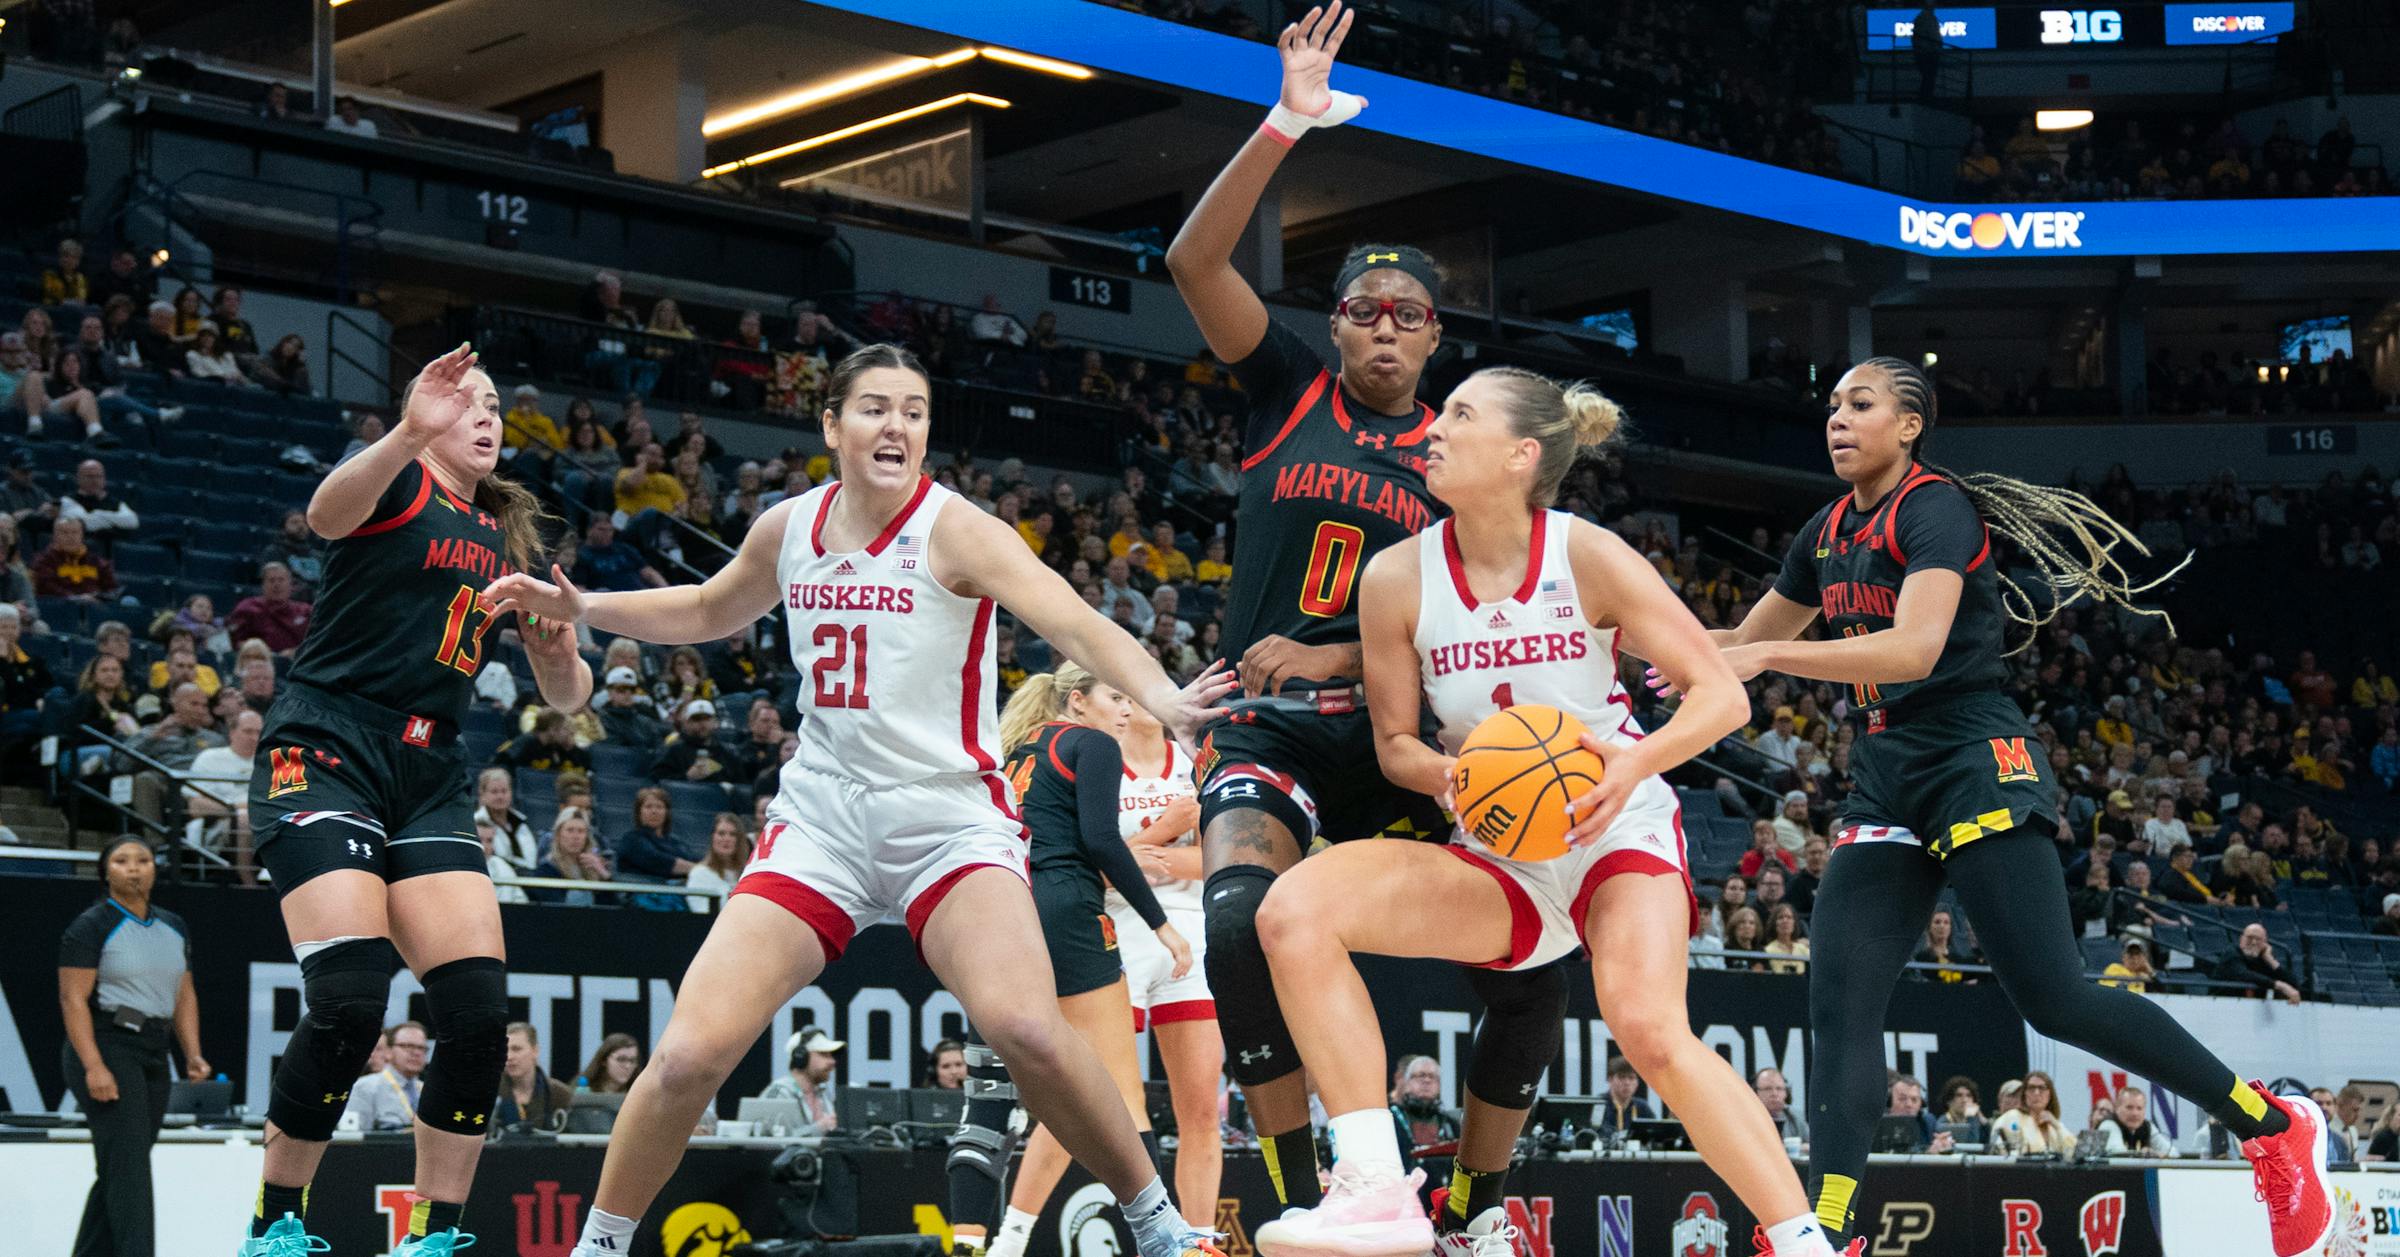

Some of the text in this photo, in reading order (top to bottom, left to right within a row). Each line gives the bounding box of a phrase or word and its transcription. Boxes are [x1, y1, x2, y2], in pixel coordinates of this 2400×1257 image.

[2192, 15, 2266, 32] DISCOVER
[477, 190, 529, 225] 112
[1071, 277, 1112, 305] 113
[2291, 429, 2334, 449] 116
[1299, 520, 1365, 618] 0
[789, 583, 914, 614] HUSKERS
[435, 584, 497, 677] 13
[1430, 631, 1588, 677] HUSKERS
[812, 623, 870, 709] 21
[1988, 736, 2038, 777] M
[1504, 1196, 1553, 1257] N
[1598, 1195, 1633, 1257] N
[1872, 1202, 1936, 1256] P
[2001, 1199, 2048, 1257] R
[2079, 1190, 2126, 1257] W
